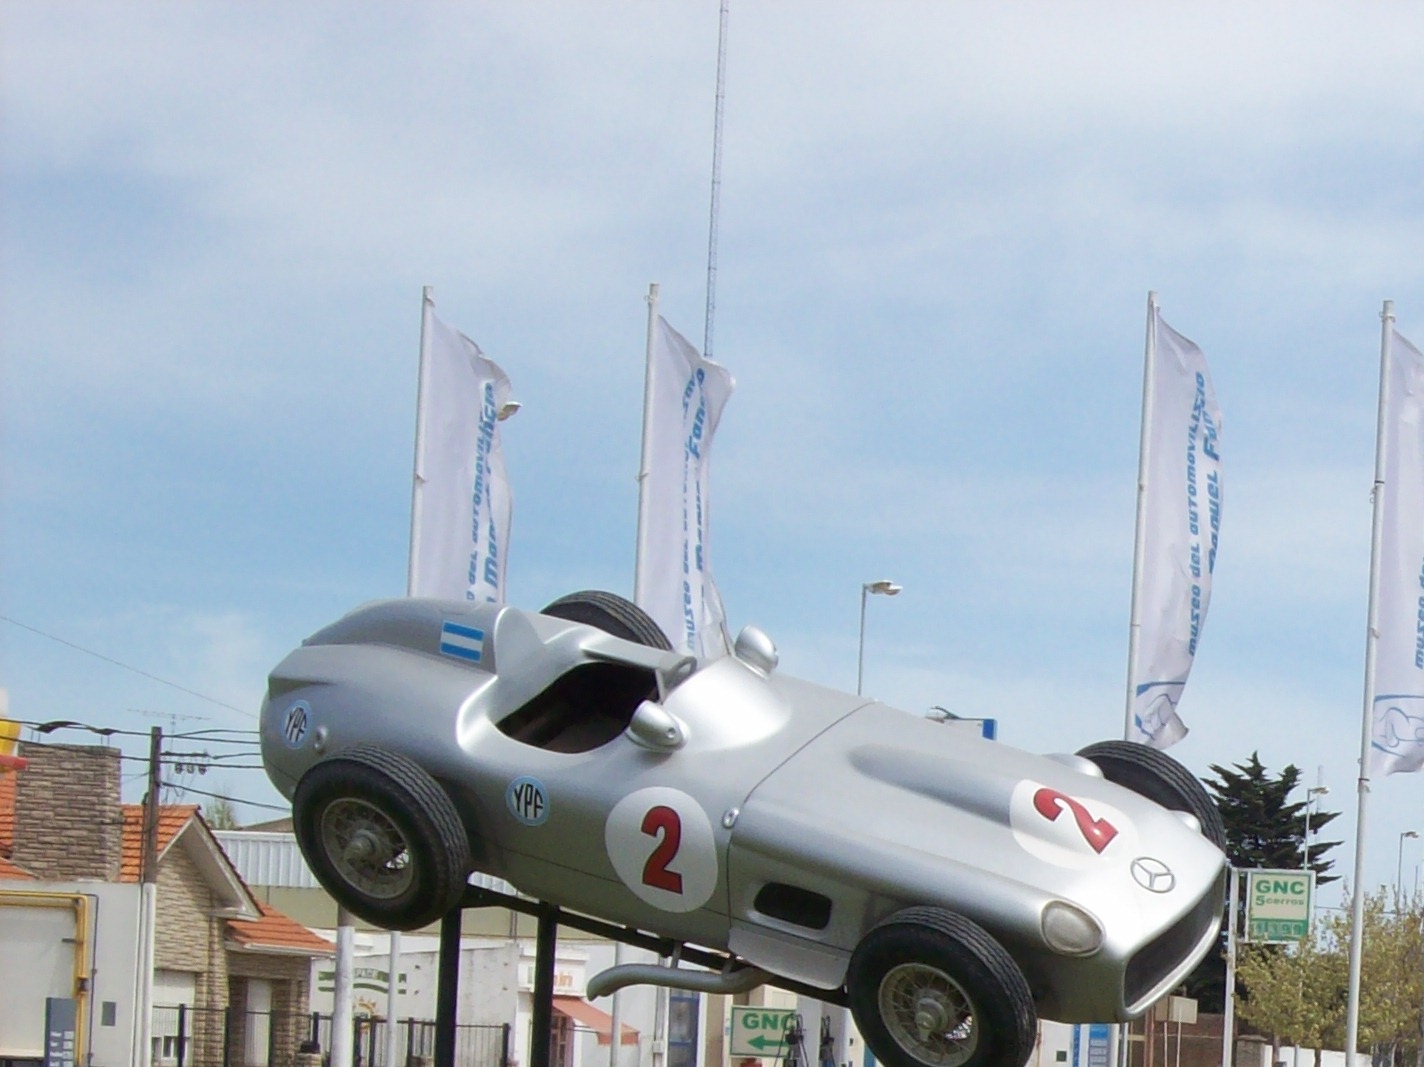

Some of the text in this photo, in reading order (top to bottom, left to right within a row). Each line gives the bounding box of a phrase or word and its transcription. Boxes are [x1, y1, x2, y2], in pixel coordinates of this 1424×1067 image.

[1189, 542, 1201, 578] del
[1188, 583, 1202, 657] museo
[285, 706, 307, 743] YPF
[512, 783, 544, 819] YPF
[1033, 787, 1119, 856] 2
[641, 805, 684, 895] 2
[1255, 880, 1305, 896] GNC
